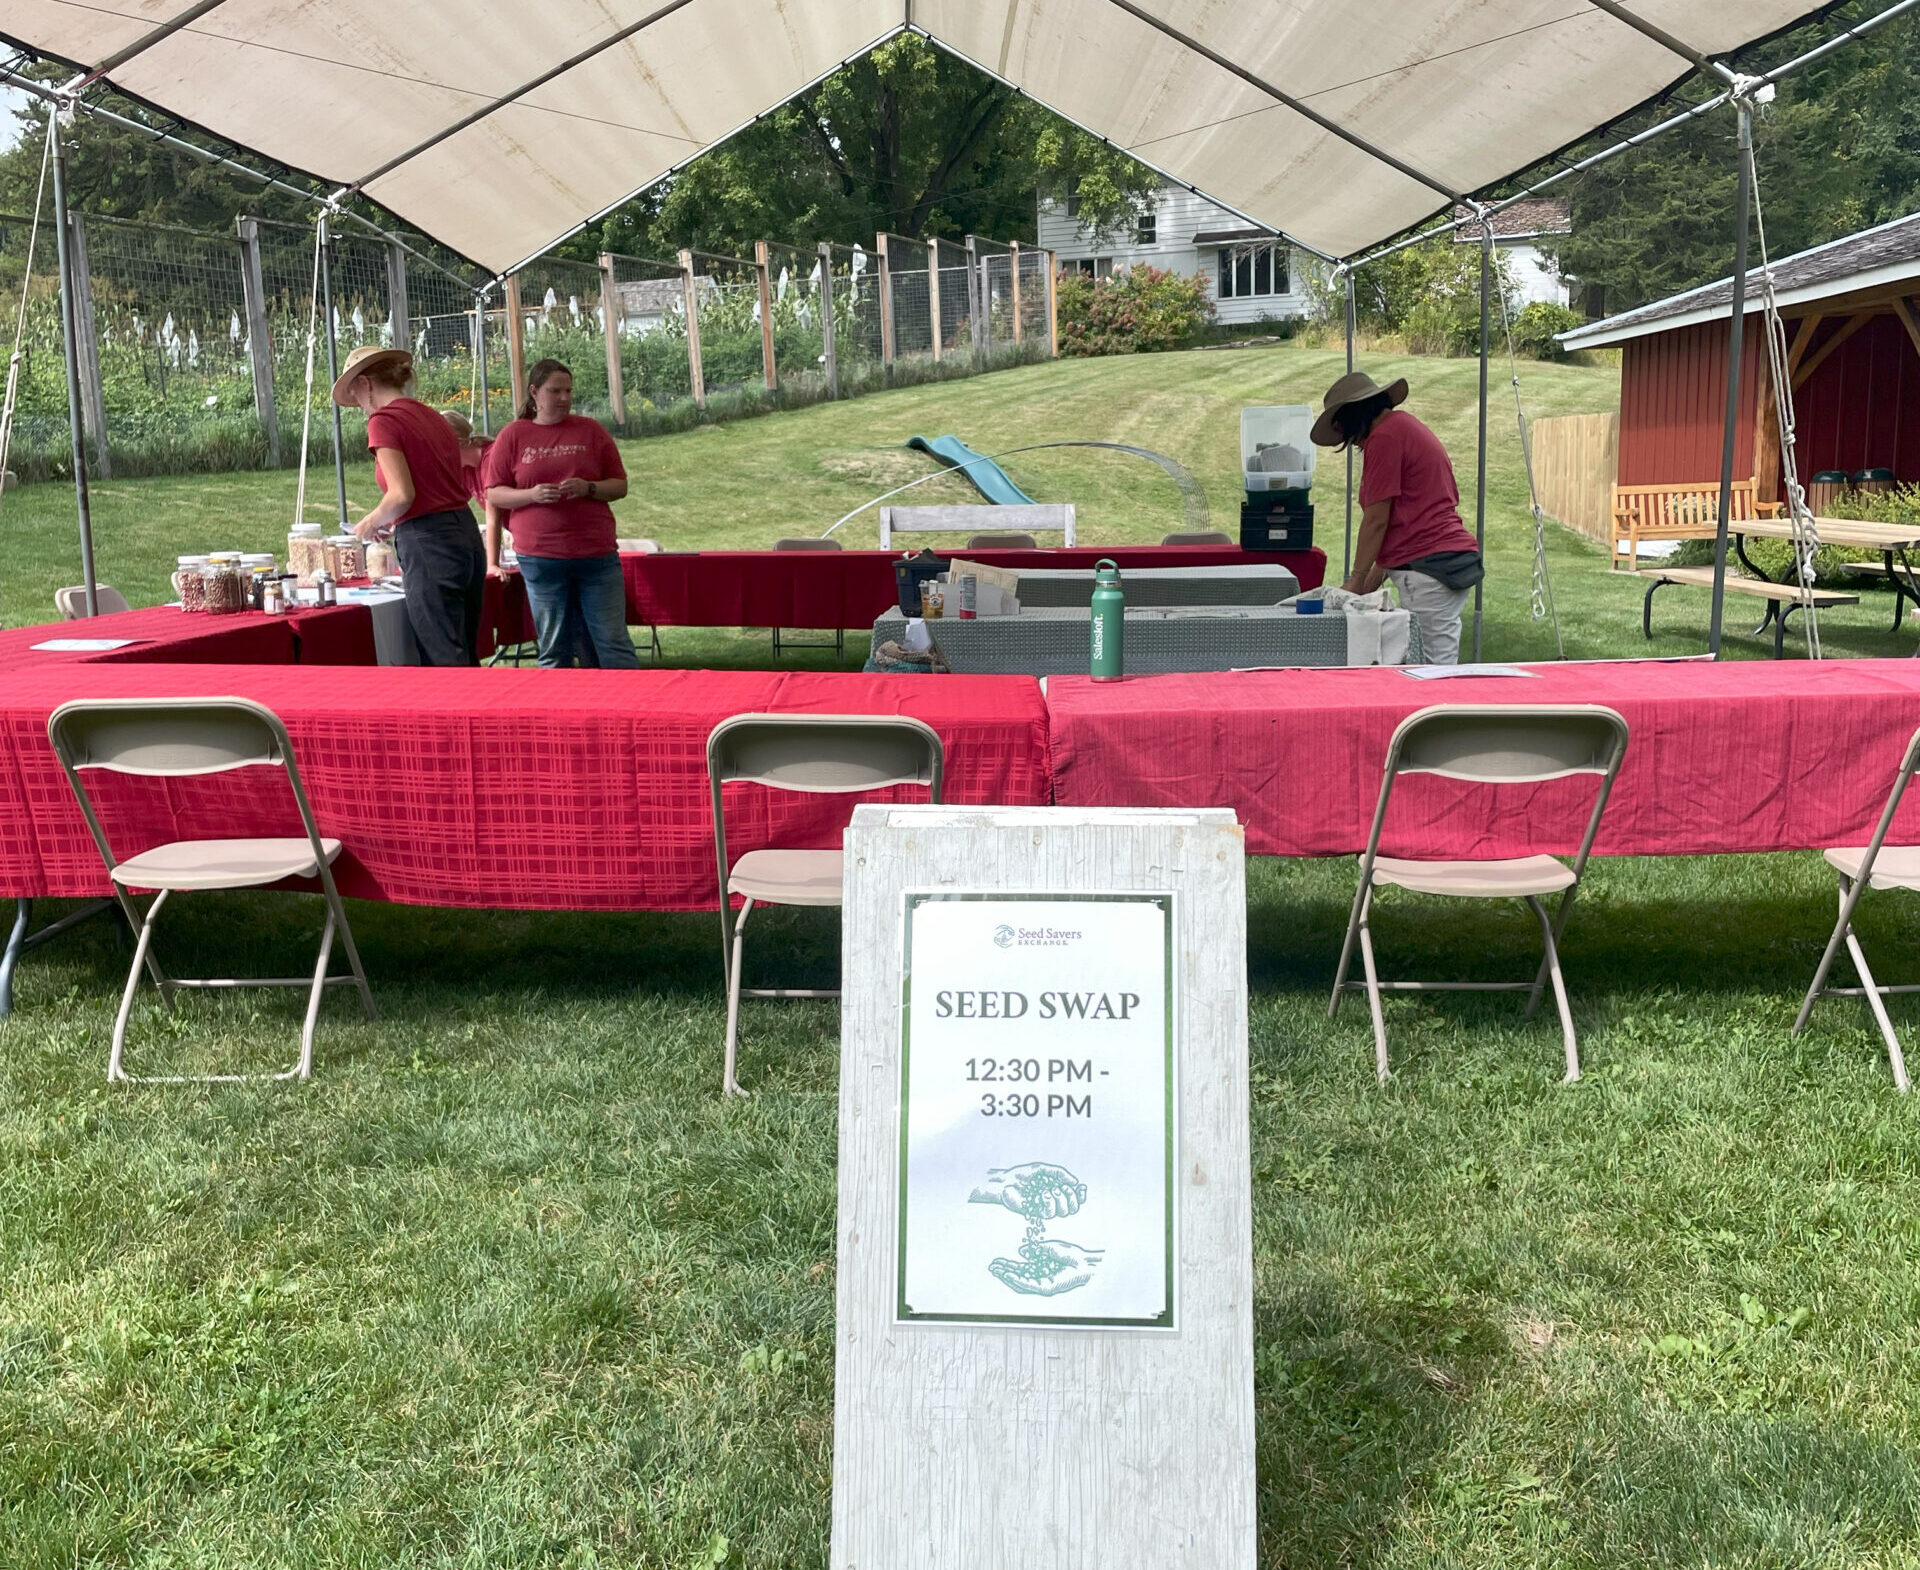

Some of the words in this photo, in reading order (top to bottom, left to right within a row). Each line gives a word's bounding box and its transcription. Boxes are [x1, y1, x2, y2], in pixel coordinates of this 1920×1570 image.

[1018, 927, 1044, 939] Seed
[1046, 927, 1082, 939] Savers
[935, 990, 1029, 1019] SEED
[1039, 991, 1140, 1020] SWAP
[965, 1058, 1040, 1082] 12:30
[1047, 1058, 1092, 1083] PM
[980, 1093, 1040, 1117] 3:30
[1047, 1094, 1092, 1118] PM
